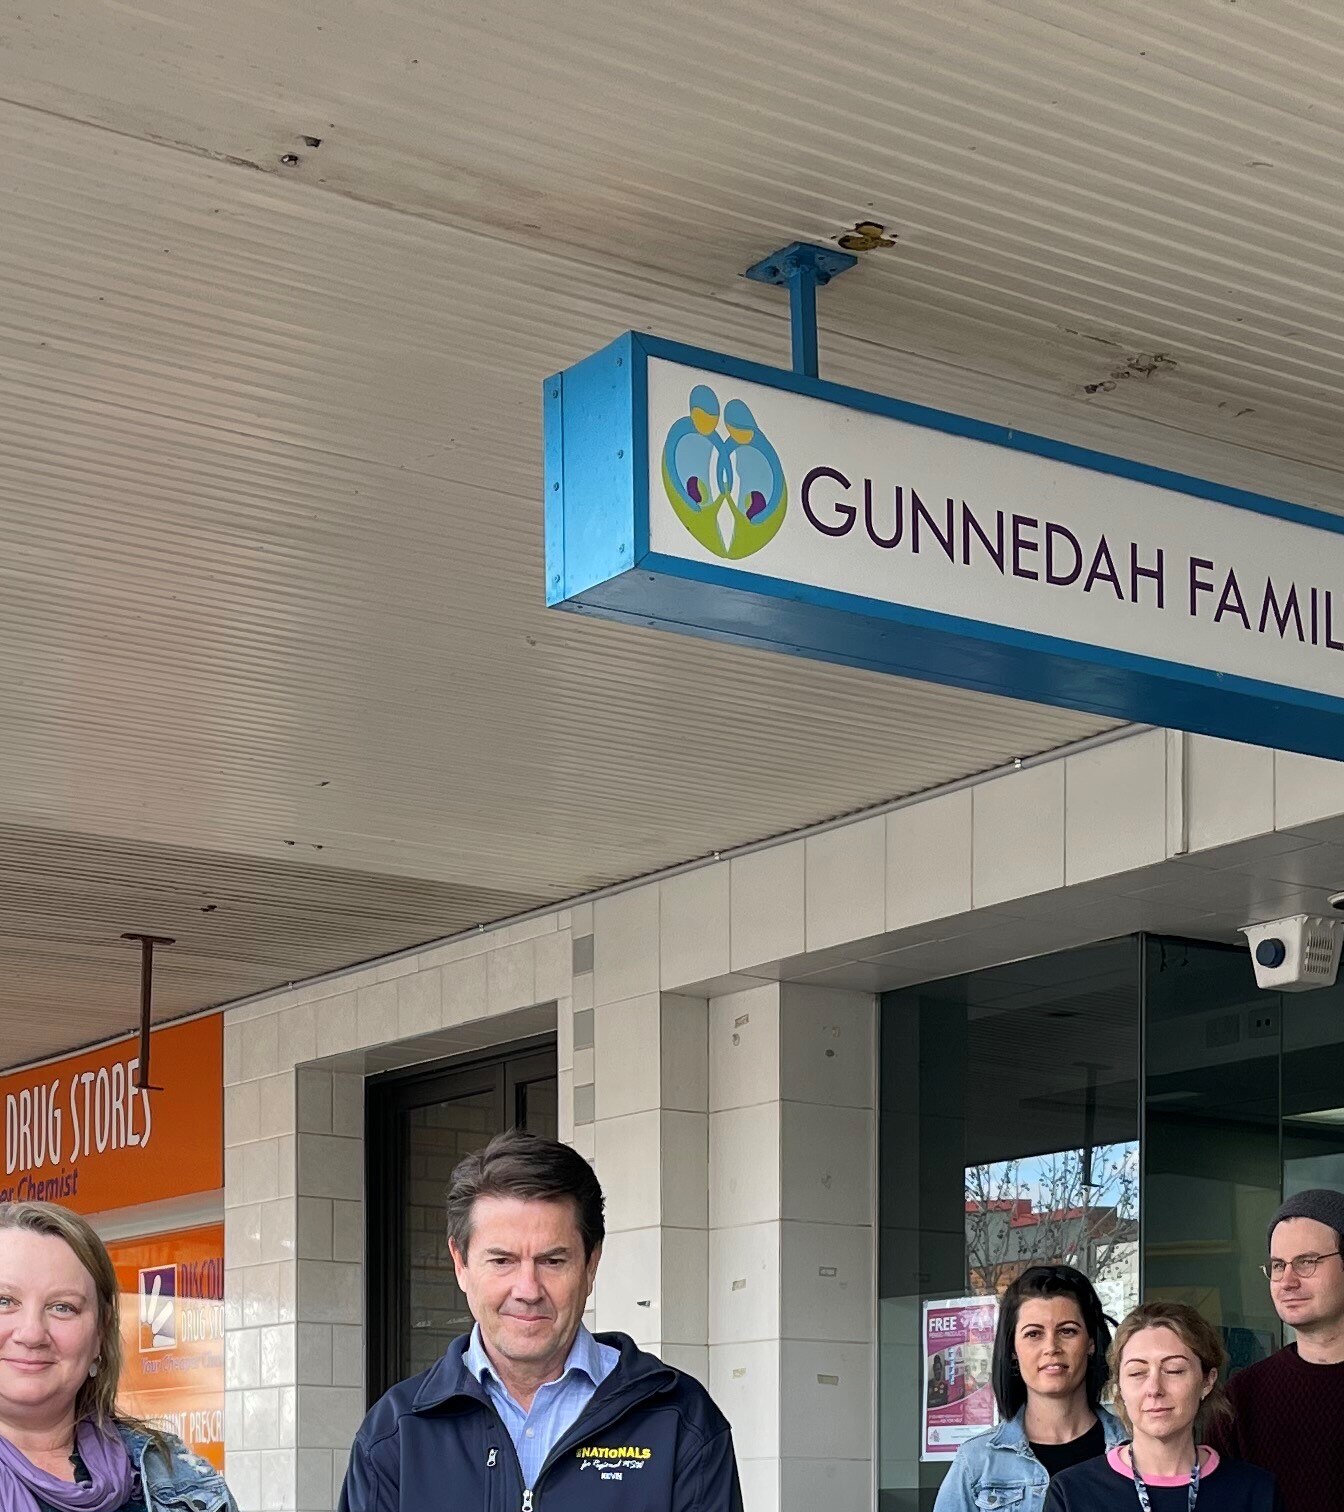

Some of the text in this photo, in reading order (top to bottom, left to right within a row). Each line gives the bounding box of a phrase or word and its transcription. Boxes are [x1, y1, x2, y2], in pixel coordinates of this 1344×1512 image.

[799, 466, 1167, 610] GUNNEDAH
[6, 1079, 62, 1175] DRUG
[70, 1057, 151, 1163] STORES
[17, 1168, 78, 1202] Chemist
[181, 1257, 224, 1300] DISCOU
[181, 1305, 224, 1343] DRUG STO
[929, 1317, 957, 1332] FREE
[582, 1447, 651, 1459] NATIONALS
